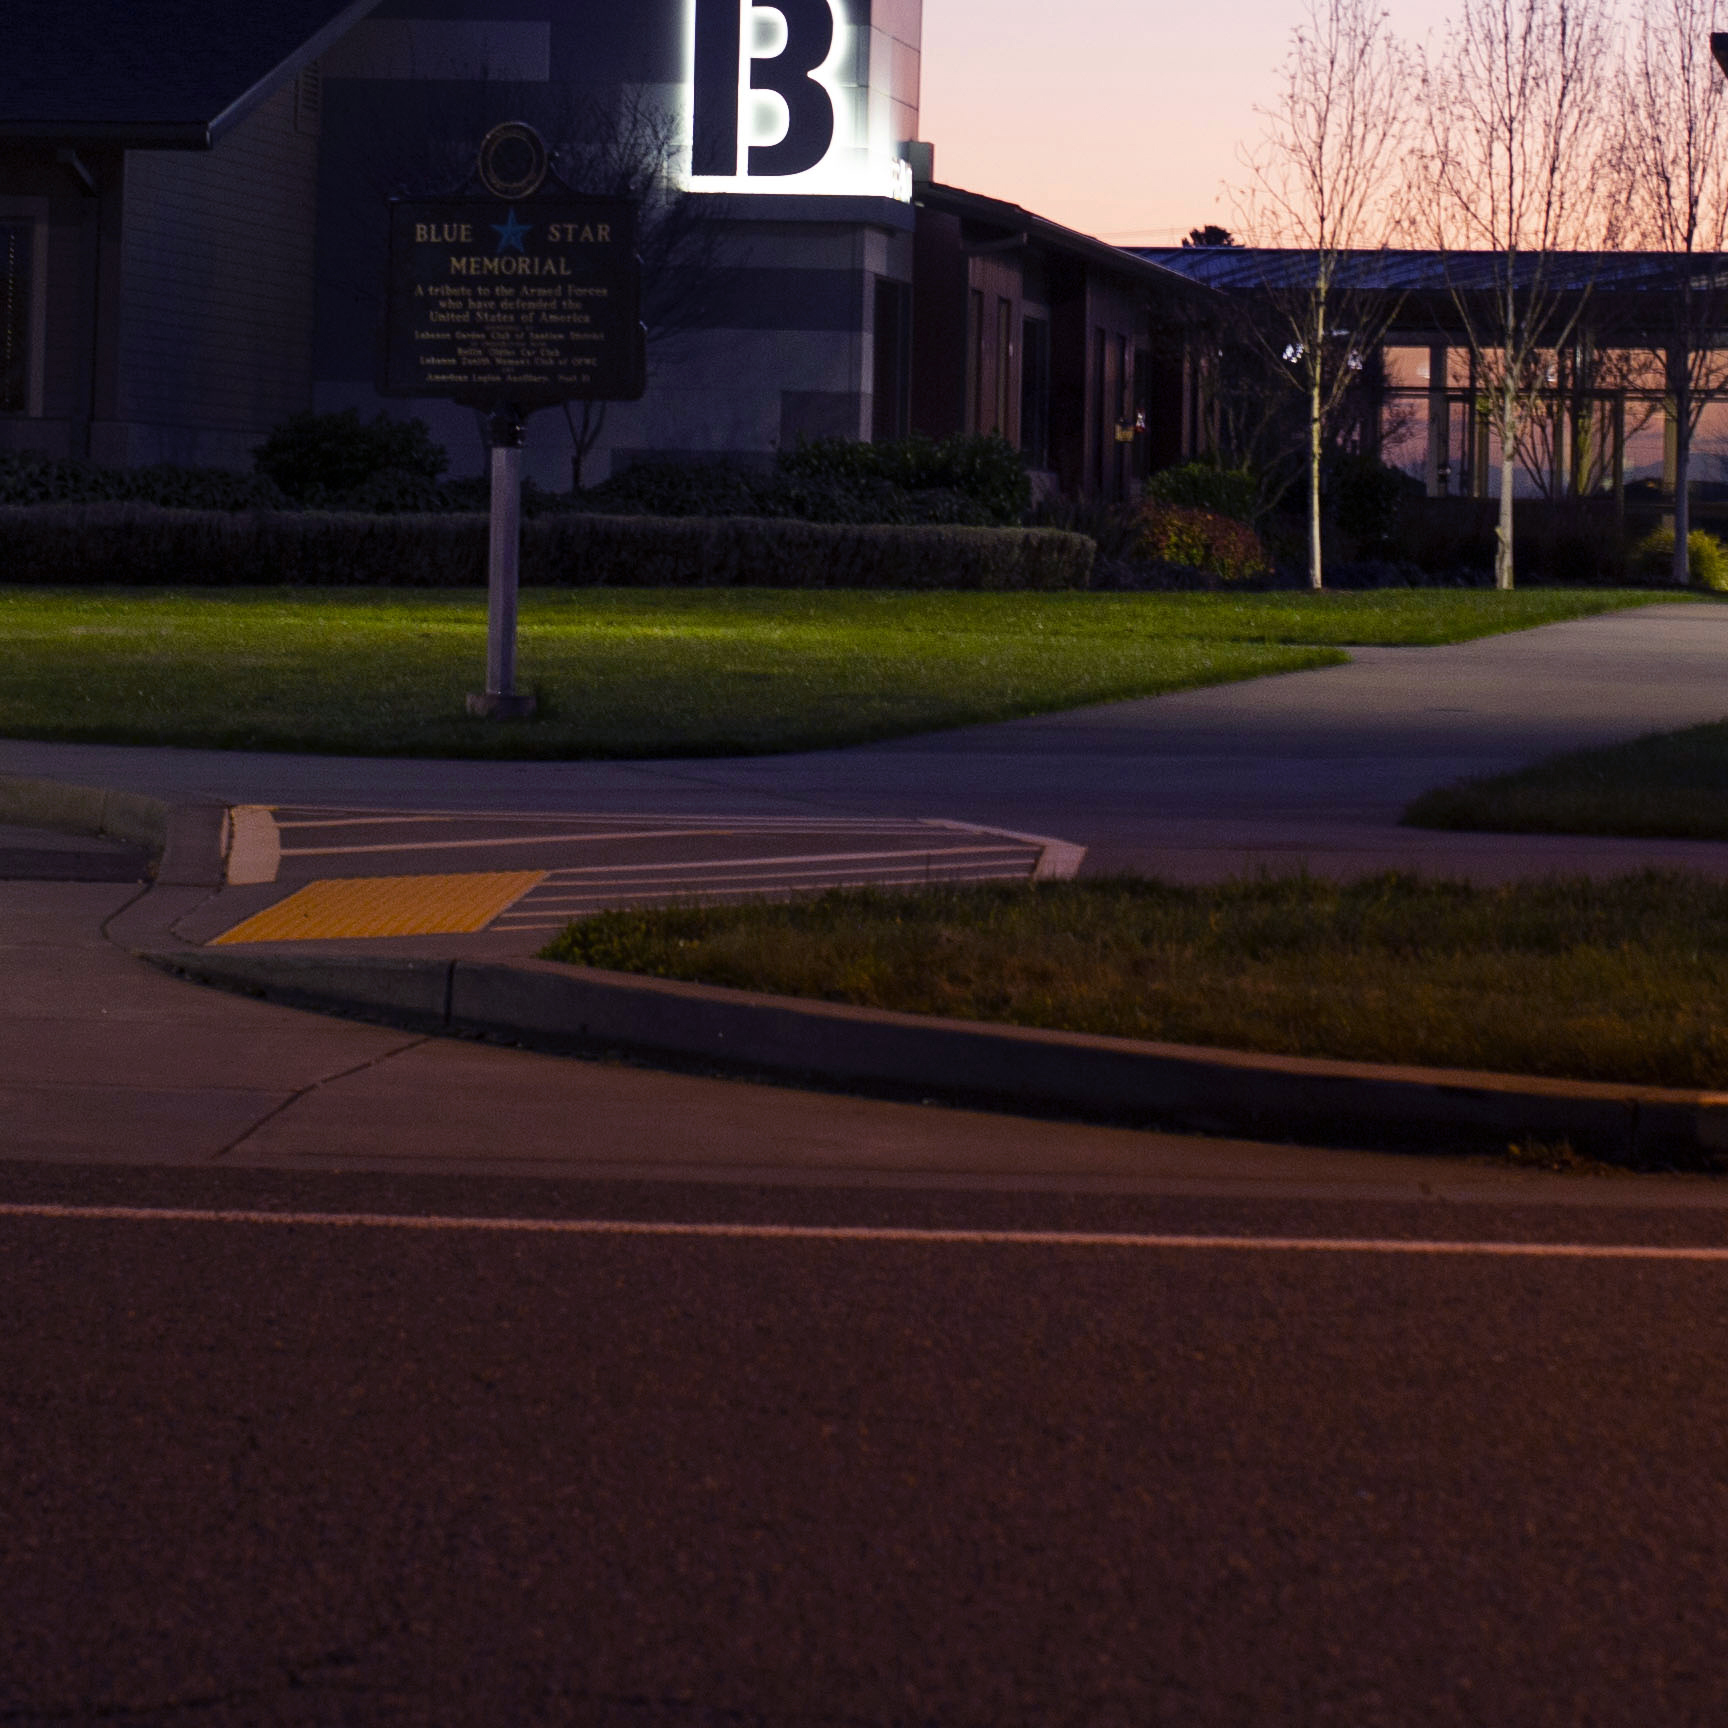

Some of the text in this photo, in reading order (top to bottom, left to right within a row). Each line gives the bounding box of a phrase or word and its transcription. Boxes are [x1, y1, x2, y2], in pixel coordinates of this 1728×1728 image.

[416, 223, 611, 243] BLUE STAR
[451, 257, 571, 276] MEMORIAL
[414, 284, 608, 296] A tribute to the Armed Forces
[439, 298, 582, 309] who have defended the
[429, 311, 590, 323] United States of America
